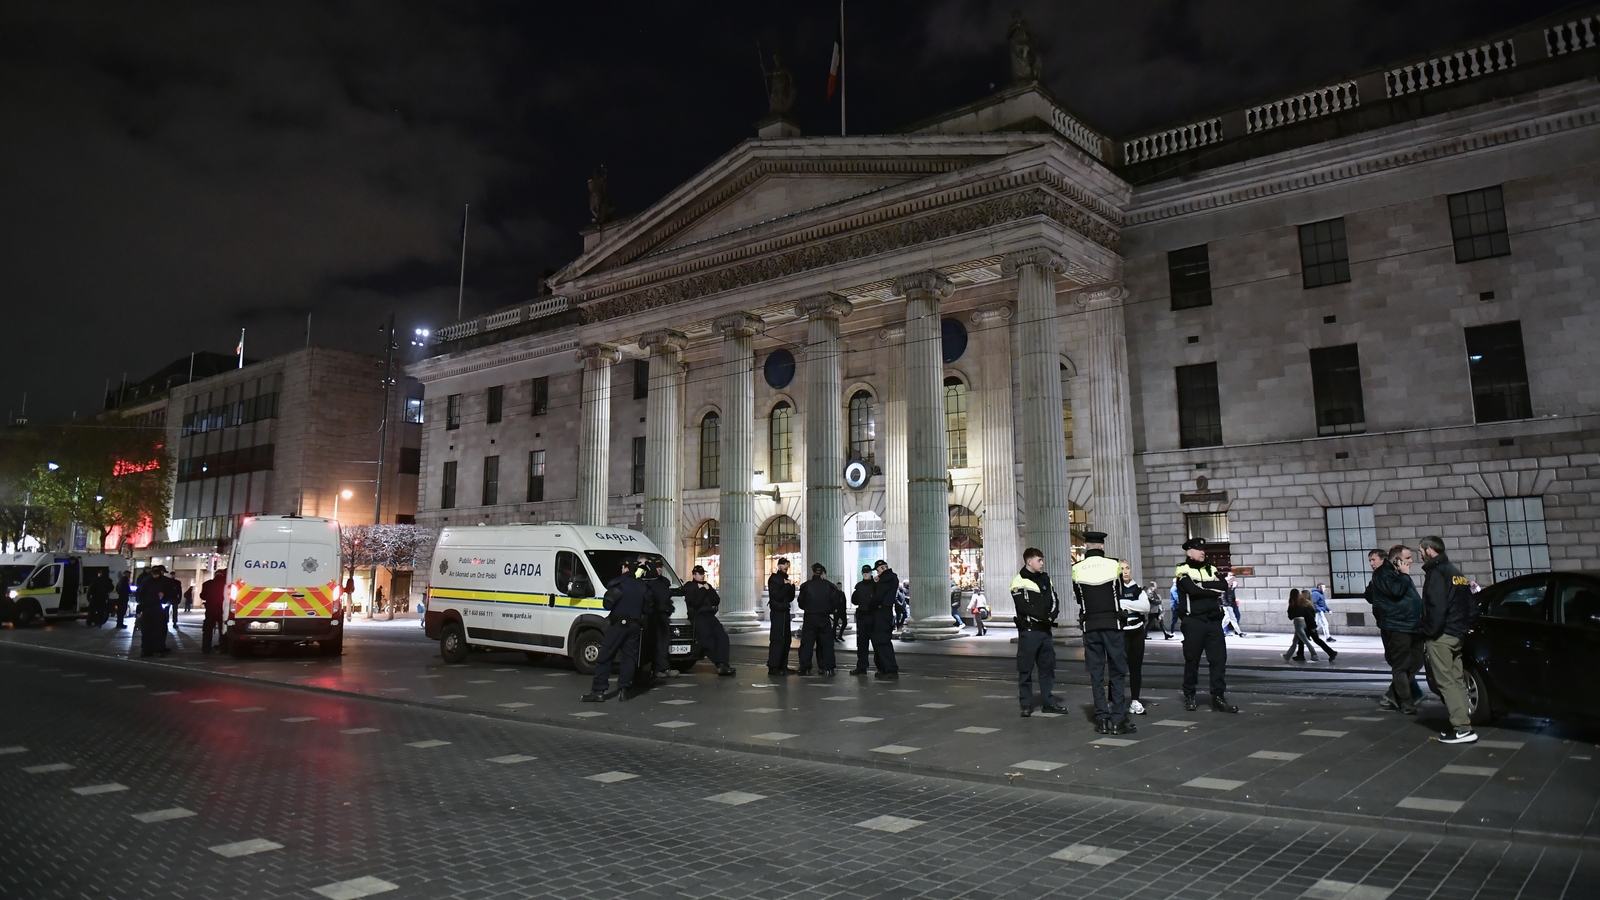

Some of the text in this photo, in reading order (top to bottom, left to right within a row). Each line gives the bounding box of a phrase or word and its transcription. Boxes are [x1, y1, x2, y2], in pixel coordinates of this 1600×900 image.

[595, 532, 638, 542] GARDA
[244, 560, 287, 569] GARDA
[504, 563, 542, 576] GARDA
[502, 612, 532, 620] www.garda.ie
